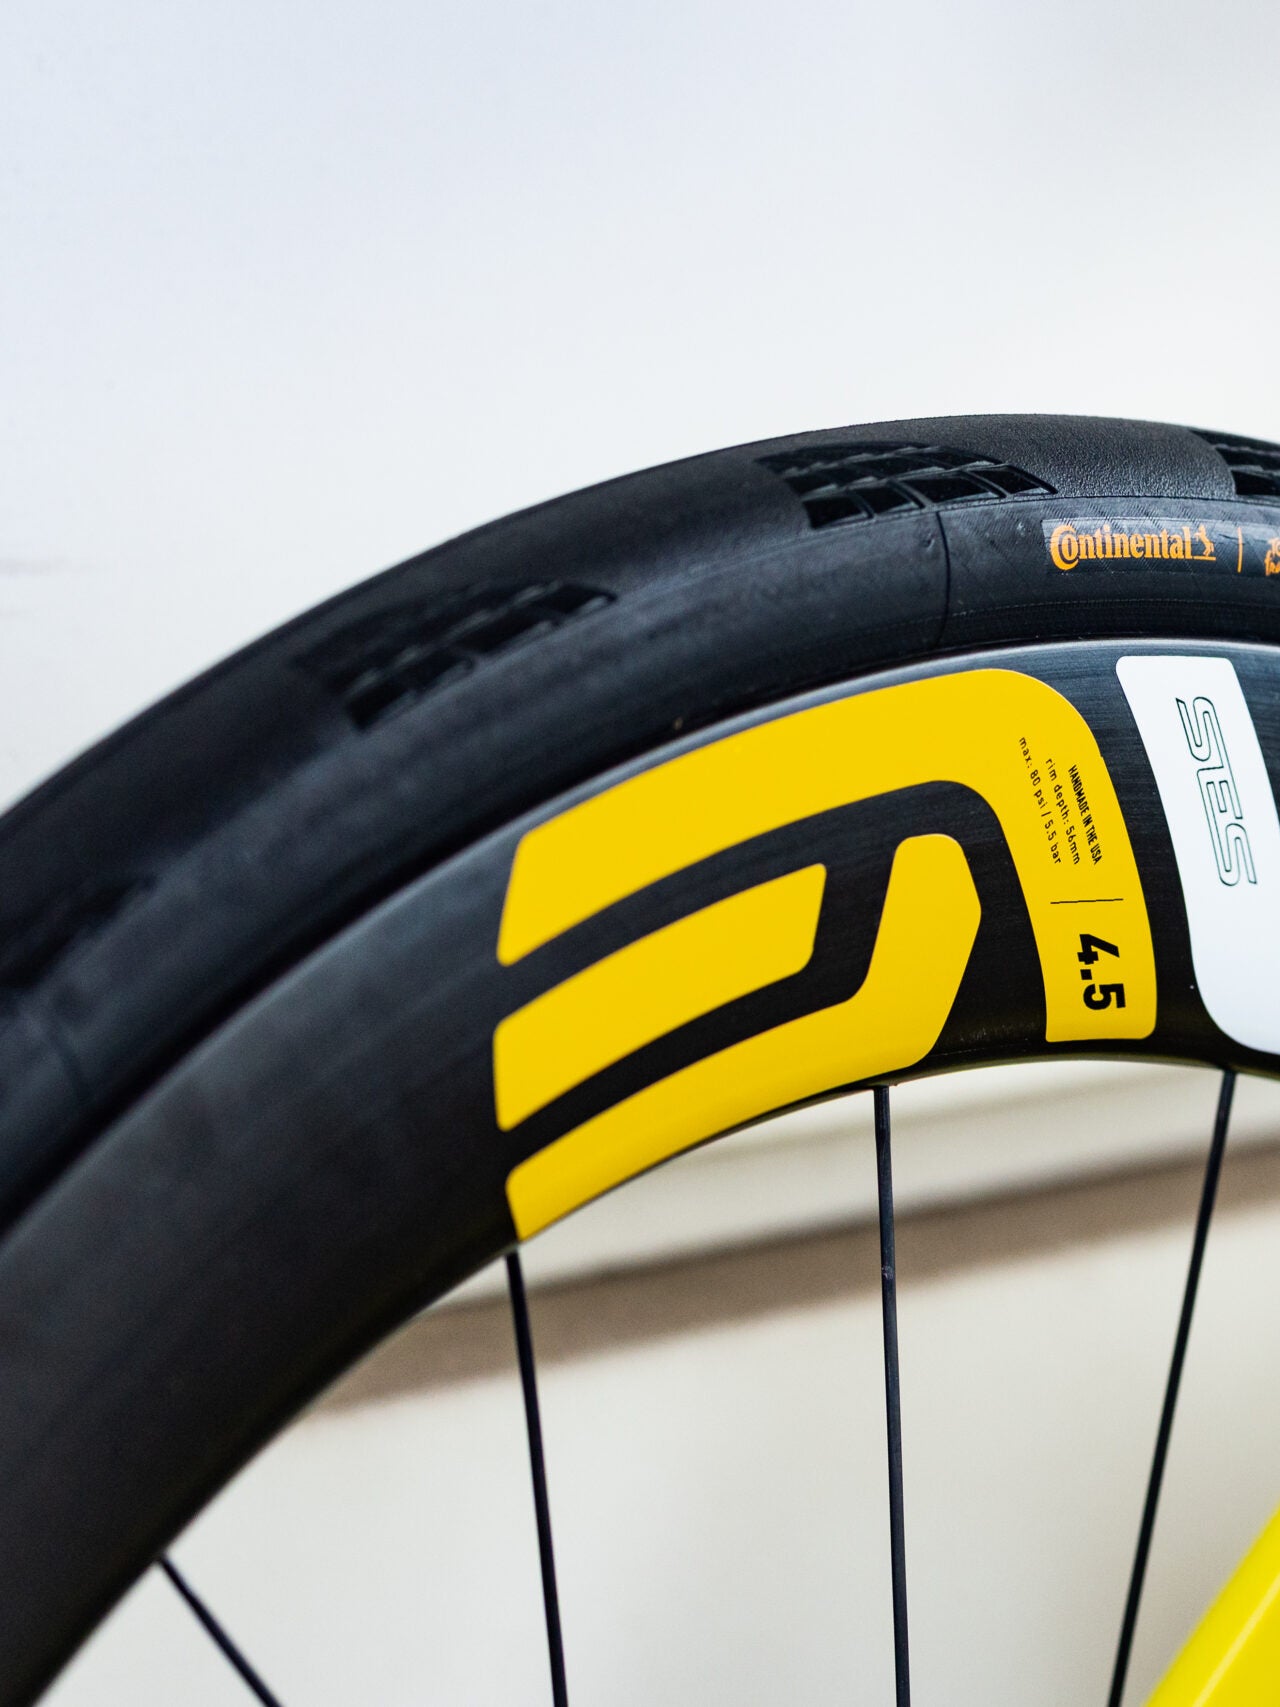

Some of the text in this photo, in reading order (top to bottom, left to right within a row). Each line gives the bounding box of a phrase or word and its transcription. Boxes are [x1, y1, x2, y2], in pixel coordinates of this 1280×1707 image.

[1050, 524, 1194, 571] Continental
[1019, 737, 1033, 769] max:
[1030, 769, 1041, 787] 80
[1175, 696, 1258, 887] SES
[1034, 789, 1048, 809] psi
[1045, 758, 1081, 865] rim depth: 56mm
[1068, 764, 1103, 866] HANDMADE IN THE USA
[1044, 819, 1057, 841] 5.5
[1050, 842, 1062, 864] bar
[1077, 933, 1127, 1011] 4.5
